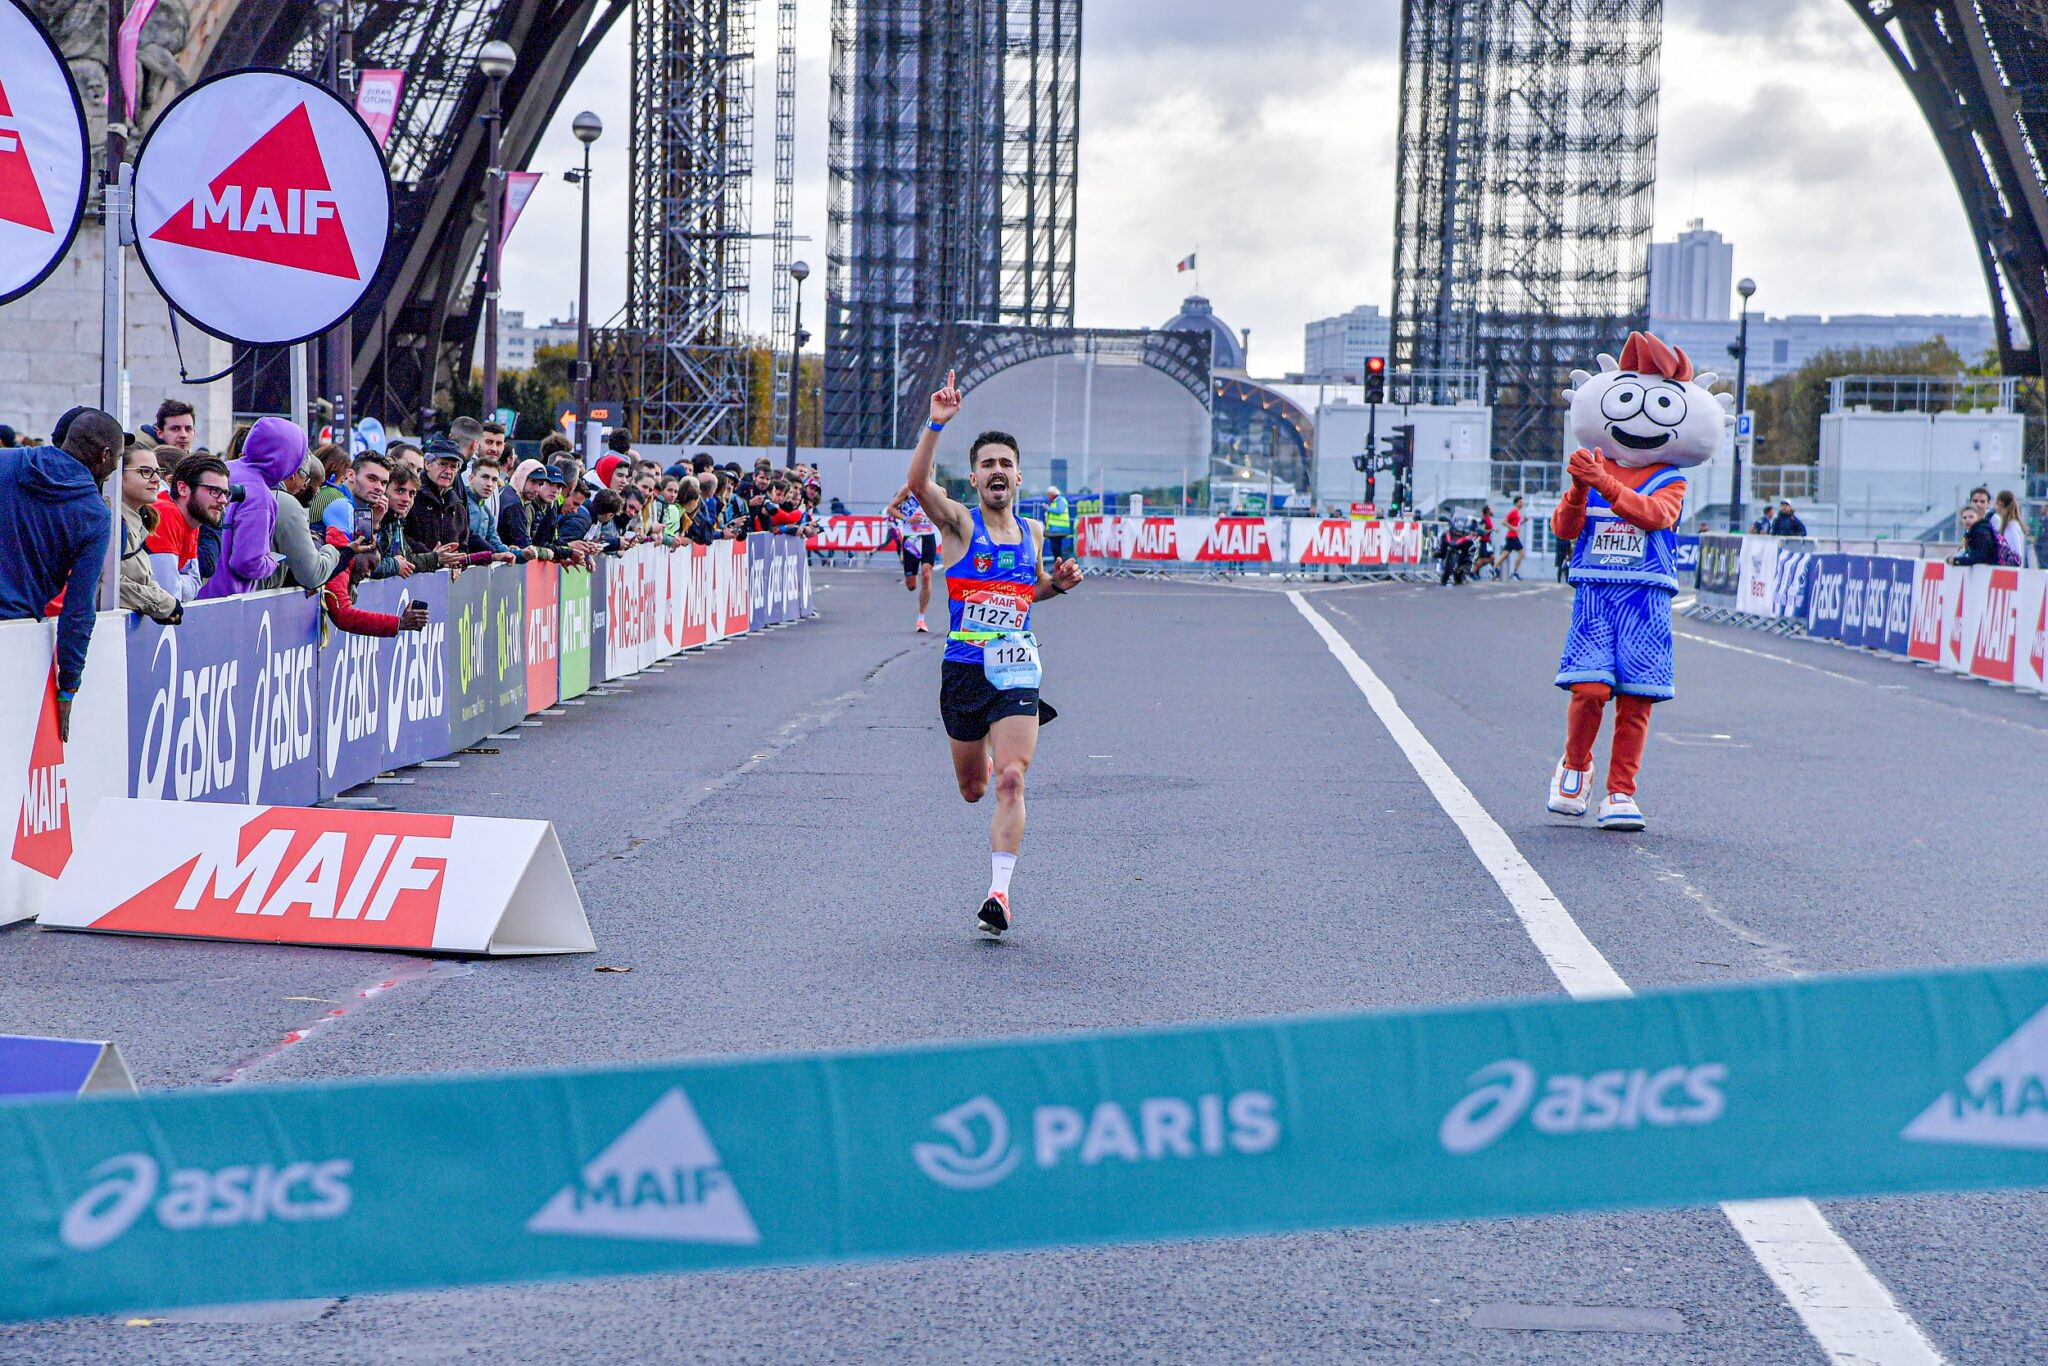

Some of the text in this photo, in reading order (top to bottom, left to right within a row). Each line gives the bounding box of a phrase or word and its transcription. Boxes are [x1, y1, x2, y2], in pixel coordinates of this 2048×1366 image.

[192, 185, 335, 235] MAIF
[1137, 524, 1175, 554] MAIF
[1207, 524, 1267, 555] MAIF
[1593, 534, 1642, 552] ATHLIX
[1610, 523, 1634, 533] MAIF
[1610, 556, 1630, 564] asics
[967, 604, 1024, 628] 1127-6
[989, 596, 1015, 608] MAIF
[1818, 573, 1843, 620] asics
[1914, 578, 1944, 645] MAIF
[1978, 588, 2017, 662] MAIF
[347, 635, 380, 742] asics
[407, 622, 444, 722] asics
[175, 660, 238, 801] asics
[270, 643, 312, 771] asics
[22, 763, 67, 838] MAIF
[174, 828, 453, 921] MAIF
[1032, 1090, 1282, 1168] PARIS
[1530, 1062, 1730, 1135] asics
[156, 1159, 354, 1230] asics
[573, 1166, 726, 1213] MAIF
